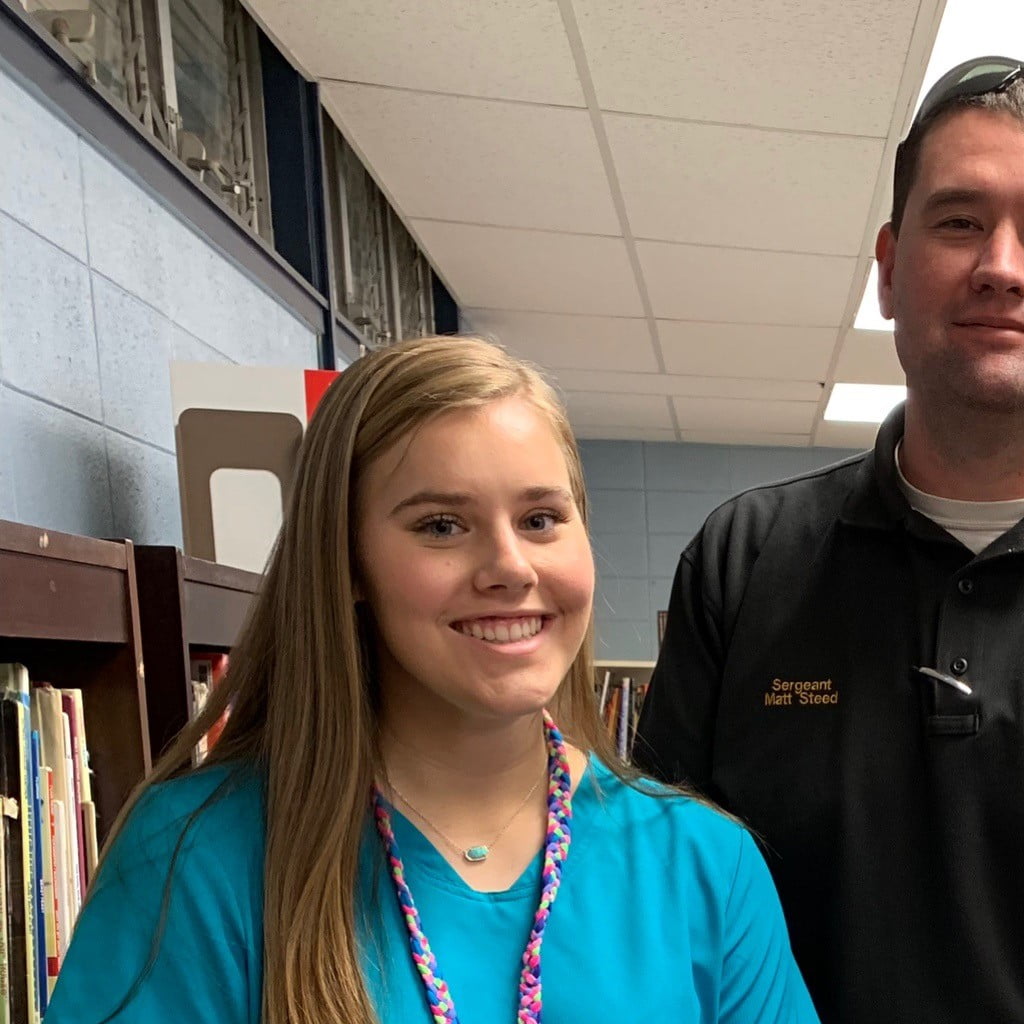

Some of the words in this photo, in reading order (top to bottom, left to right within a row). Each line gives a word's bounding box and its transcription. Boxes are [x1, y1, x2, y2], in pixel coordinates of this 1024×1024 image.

[772, 678, 833, 694] Sergeant
[764, 692, 793, 706] Matt
[799, 690, 839, 705] Steed
